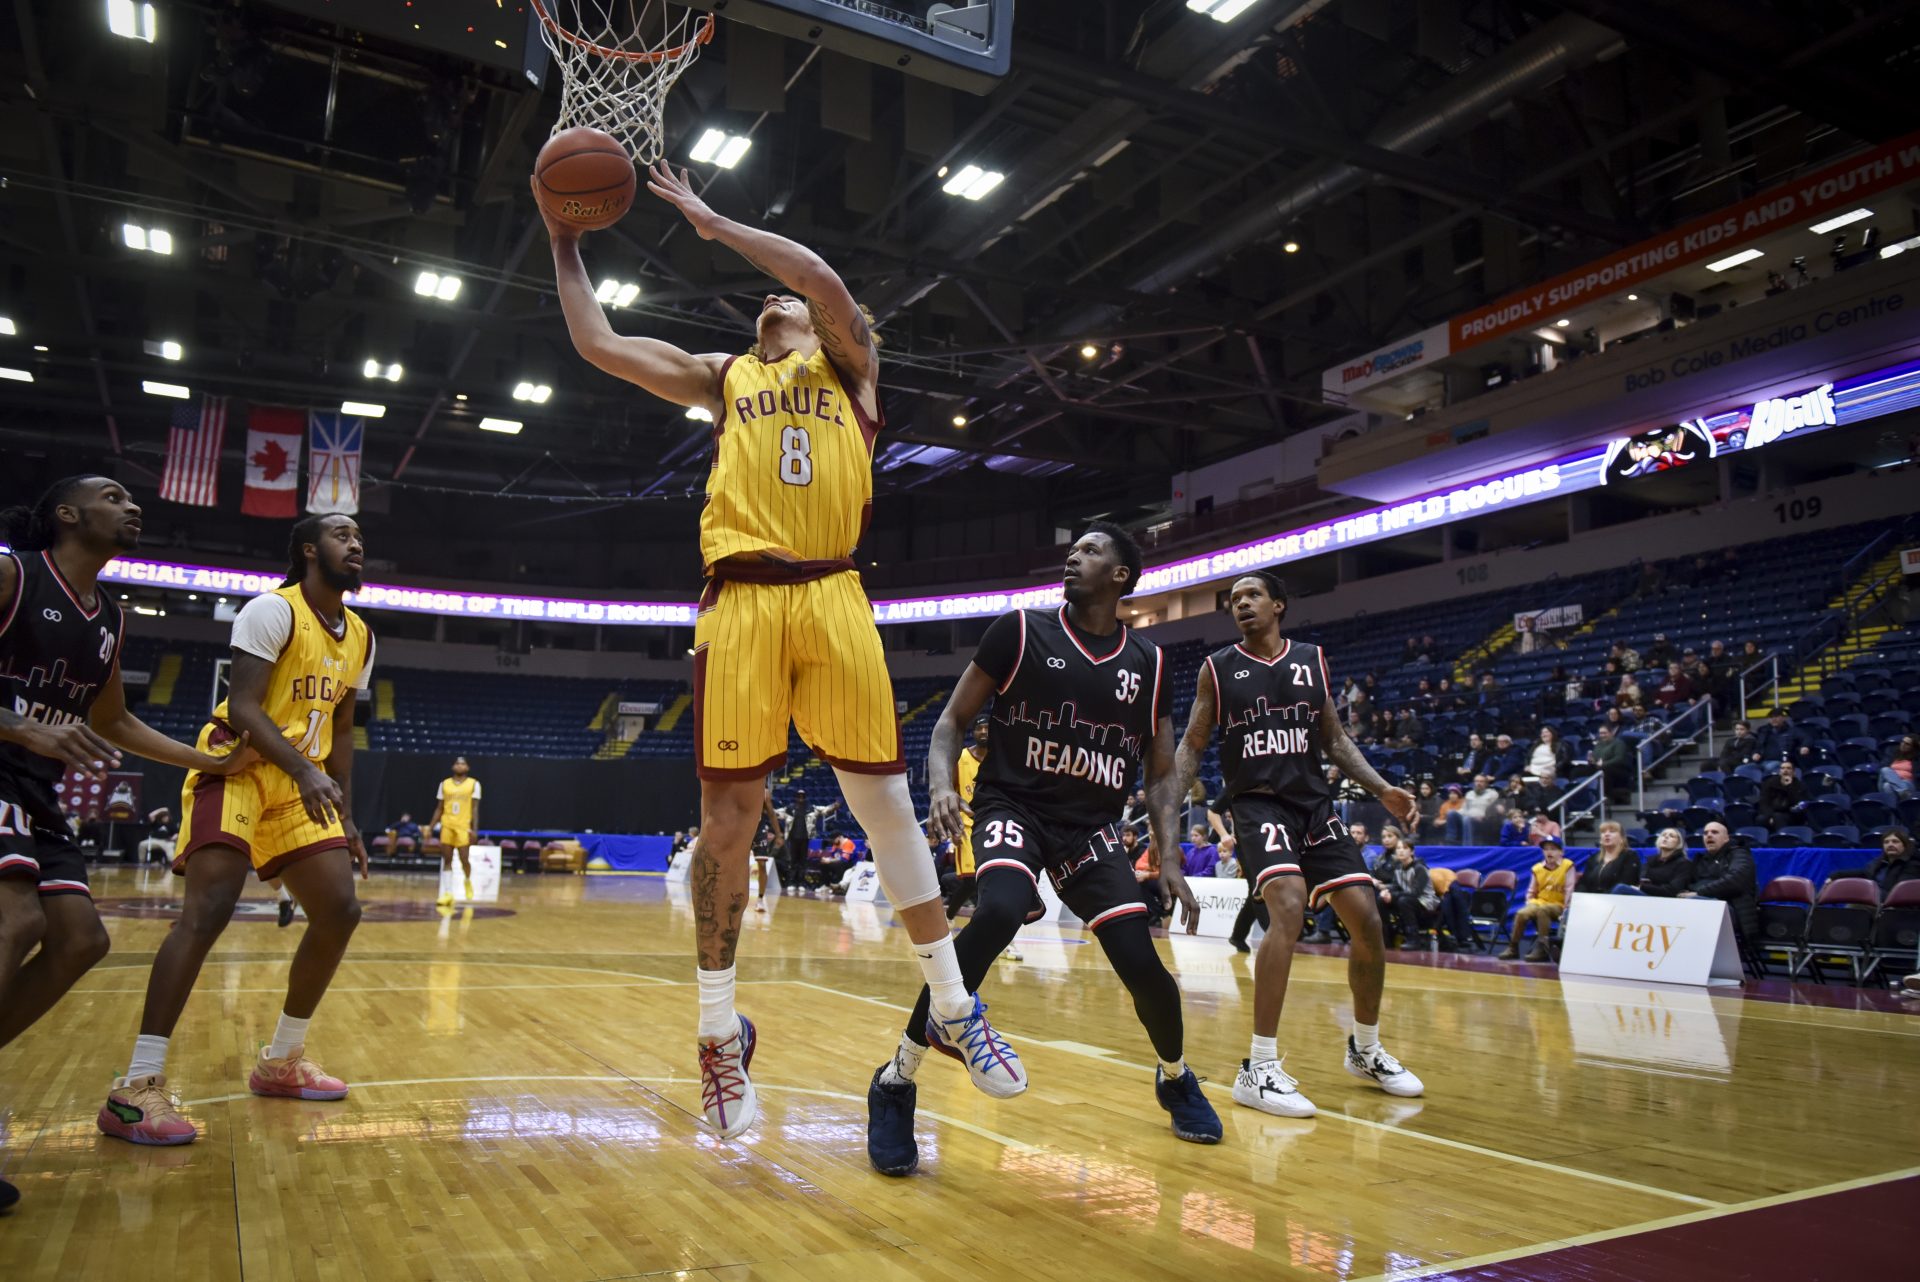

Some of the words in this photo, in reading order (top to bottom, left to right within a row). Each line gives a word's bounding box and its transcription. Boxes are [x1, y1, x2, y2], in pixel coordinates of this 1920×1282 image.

[1461, 294, 1544, 341] PROUDLY
[1549, 241, 1679, 306] SUPPORTING
[1683, 216, 1738, 253] KIDS
[1743, 196, 1795, 231] AND
[1799, 156, 1893, 207] YOUTH
[1626, 367, 1666, 393] Bob
[1672, 350, 1723, 377] Cole
[1730, 322, 1808, 361] Media
[1814, 293, 1905, 334] Centre
[779, 424, 813, 487] 8
[1212, 534, 1301, 575] SPONSOR
[1303, 525, 1331, 550] OF
[1334, 512, 1379, 543] THE
[1382, 496, 1446, 532] NFLD
[1449, 464, 1562, 514] ROGUES
[1774, 496, 1822, 524] 109
[356, 585, 464, 611] SPONSOR
[467, 596, 501, 613] OF
[502, 598, 545, 617] THE
[547, 600, 603, 620] NFLD
[606, 604, 691, 622] ROGUES
[887, 599, 939, 619] AUTO
[940, 594, 1008, 616] GROUP
[98, 626, 115, 664] 20
[496, 655, 521, 667] 104
[1115, 668, 1142, 704] 35
[1289, 663, 1313, 687] 21
[1242, 727, 1310, 759] READING
[1025, 735, 1126, 791] READING
[983, 819, 1025, 849] 35
[1259, 821, 1293, 853] 21
